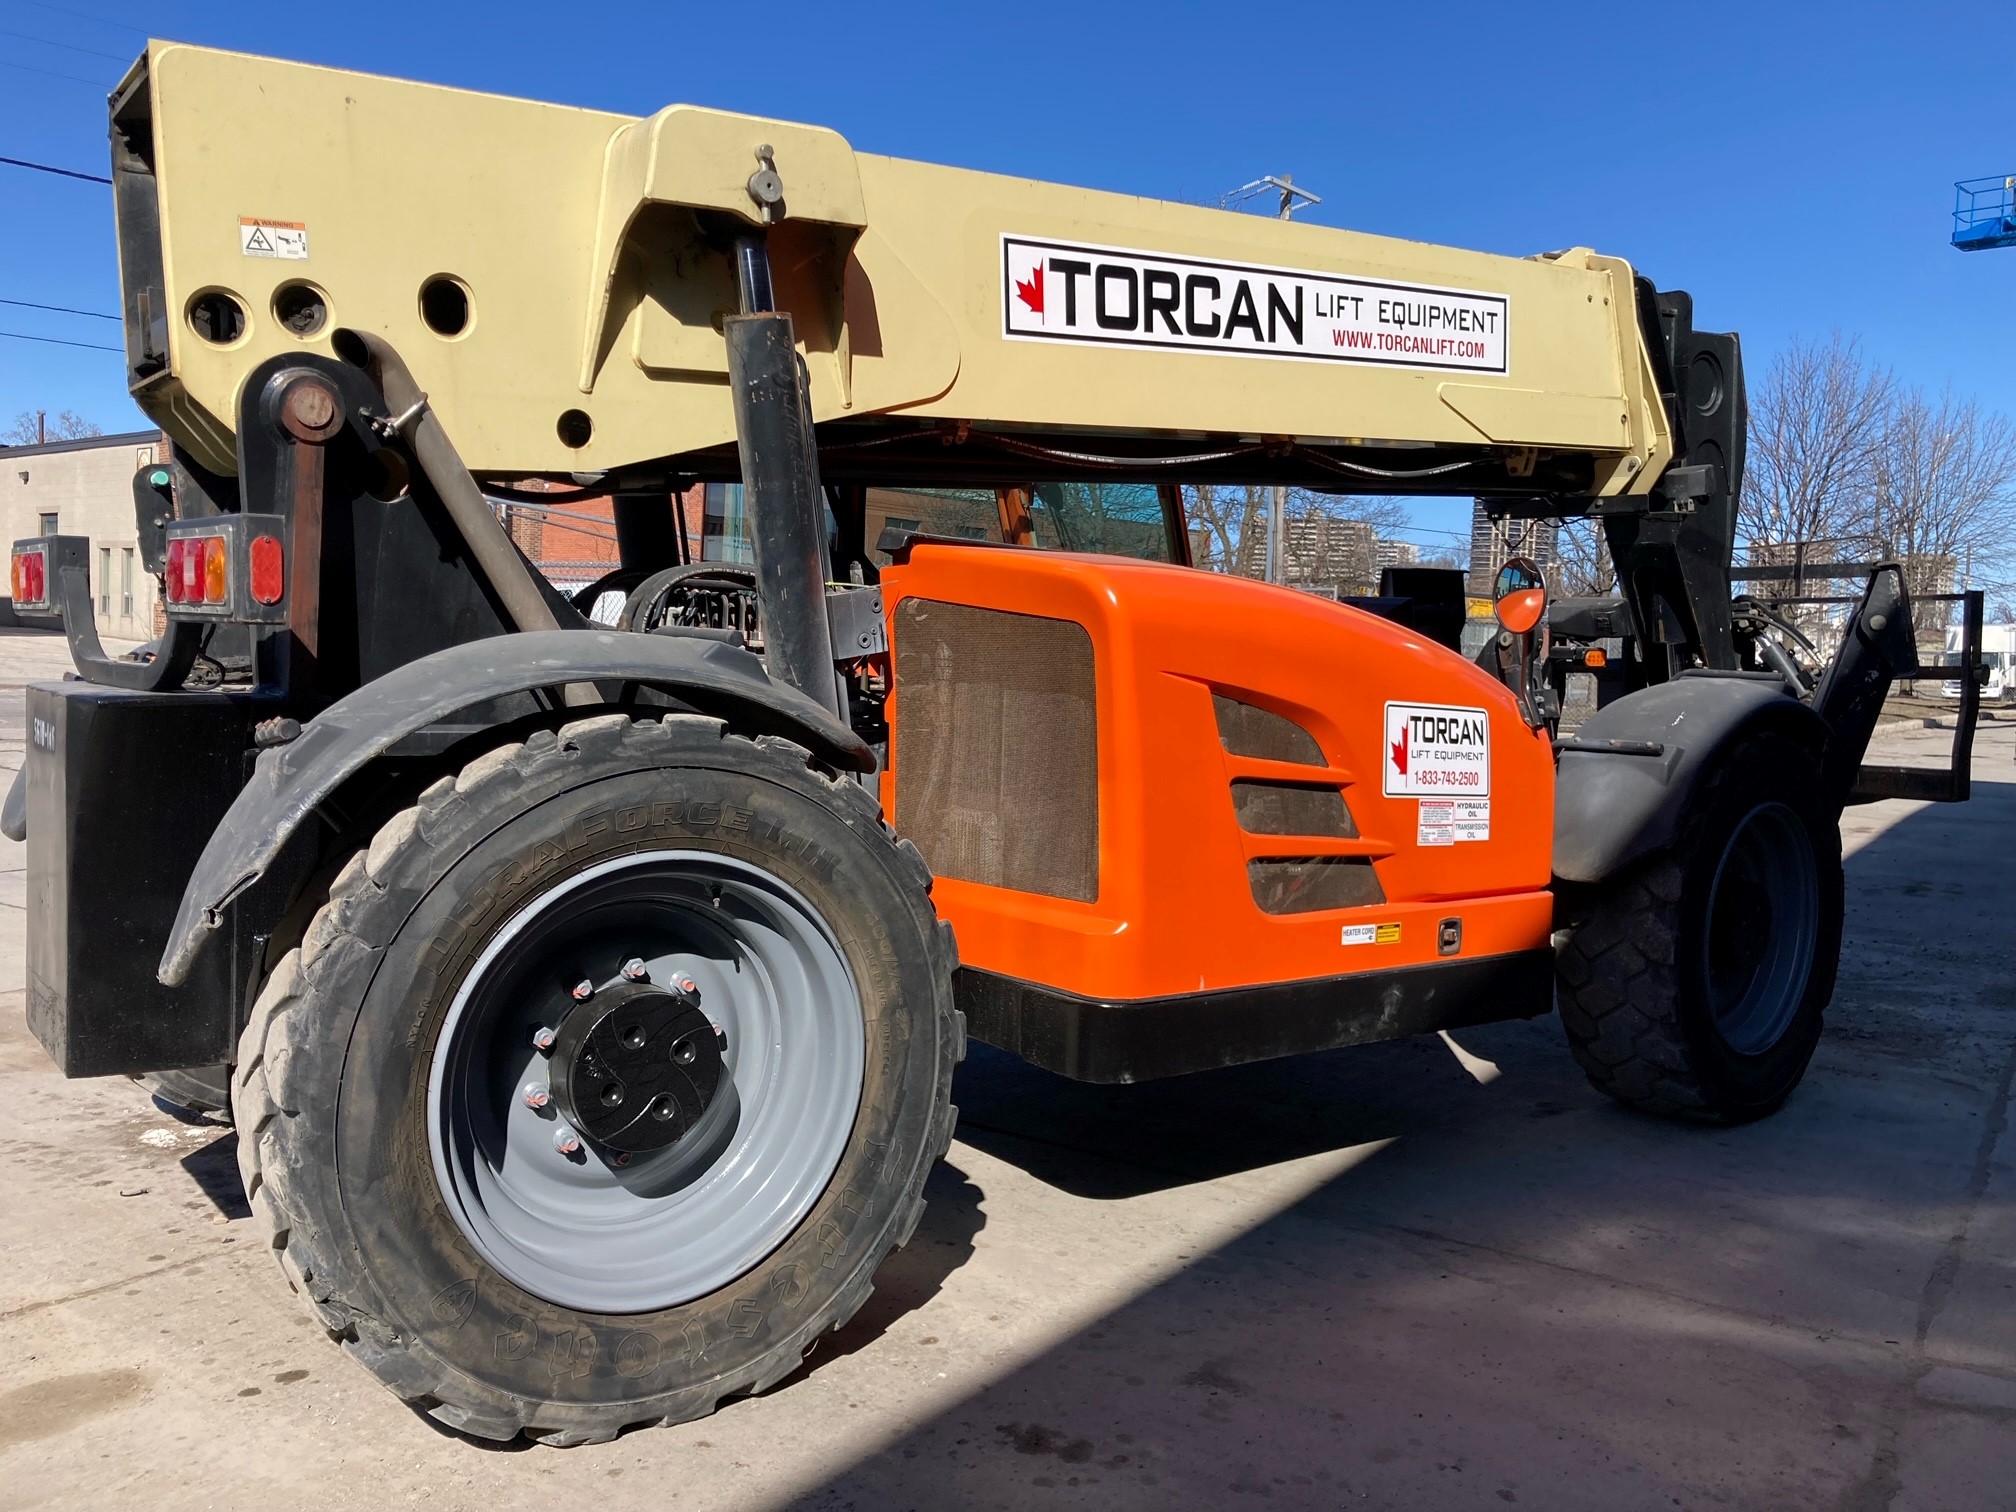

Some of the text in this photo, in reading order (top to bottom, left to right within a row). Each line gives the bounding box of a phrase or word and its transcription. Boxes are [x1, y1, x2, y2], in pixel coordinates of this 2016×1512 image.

[261, 220, 294, 229] WARNING
[1048, 257, 1303, 345] TORCAN
[1315, 292, 1499, 335] LIFT EQUIPMENT
[1332, 329, 1485, 359] WWW.TORCANLIFT.COM
[1409, 715, 1485, 746] TORCAN
[1411, 750, 1485, 761] LIFT EQUIPMENT
[1414, 770, 1479, 787] 1-833-743-2500
[1457, 802, 1489, 810] HYDRAULIC
[1455, 823, 1489, 831] TRANSMISSION
[1343, 928, 1361, 937] HEATER
[1362, 927, 1375, 936] CORD
[405, 999, 432, 1048] NYLON
